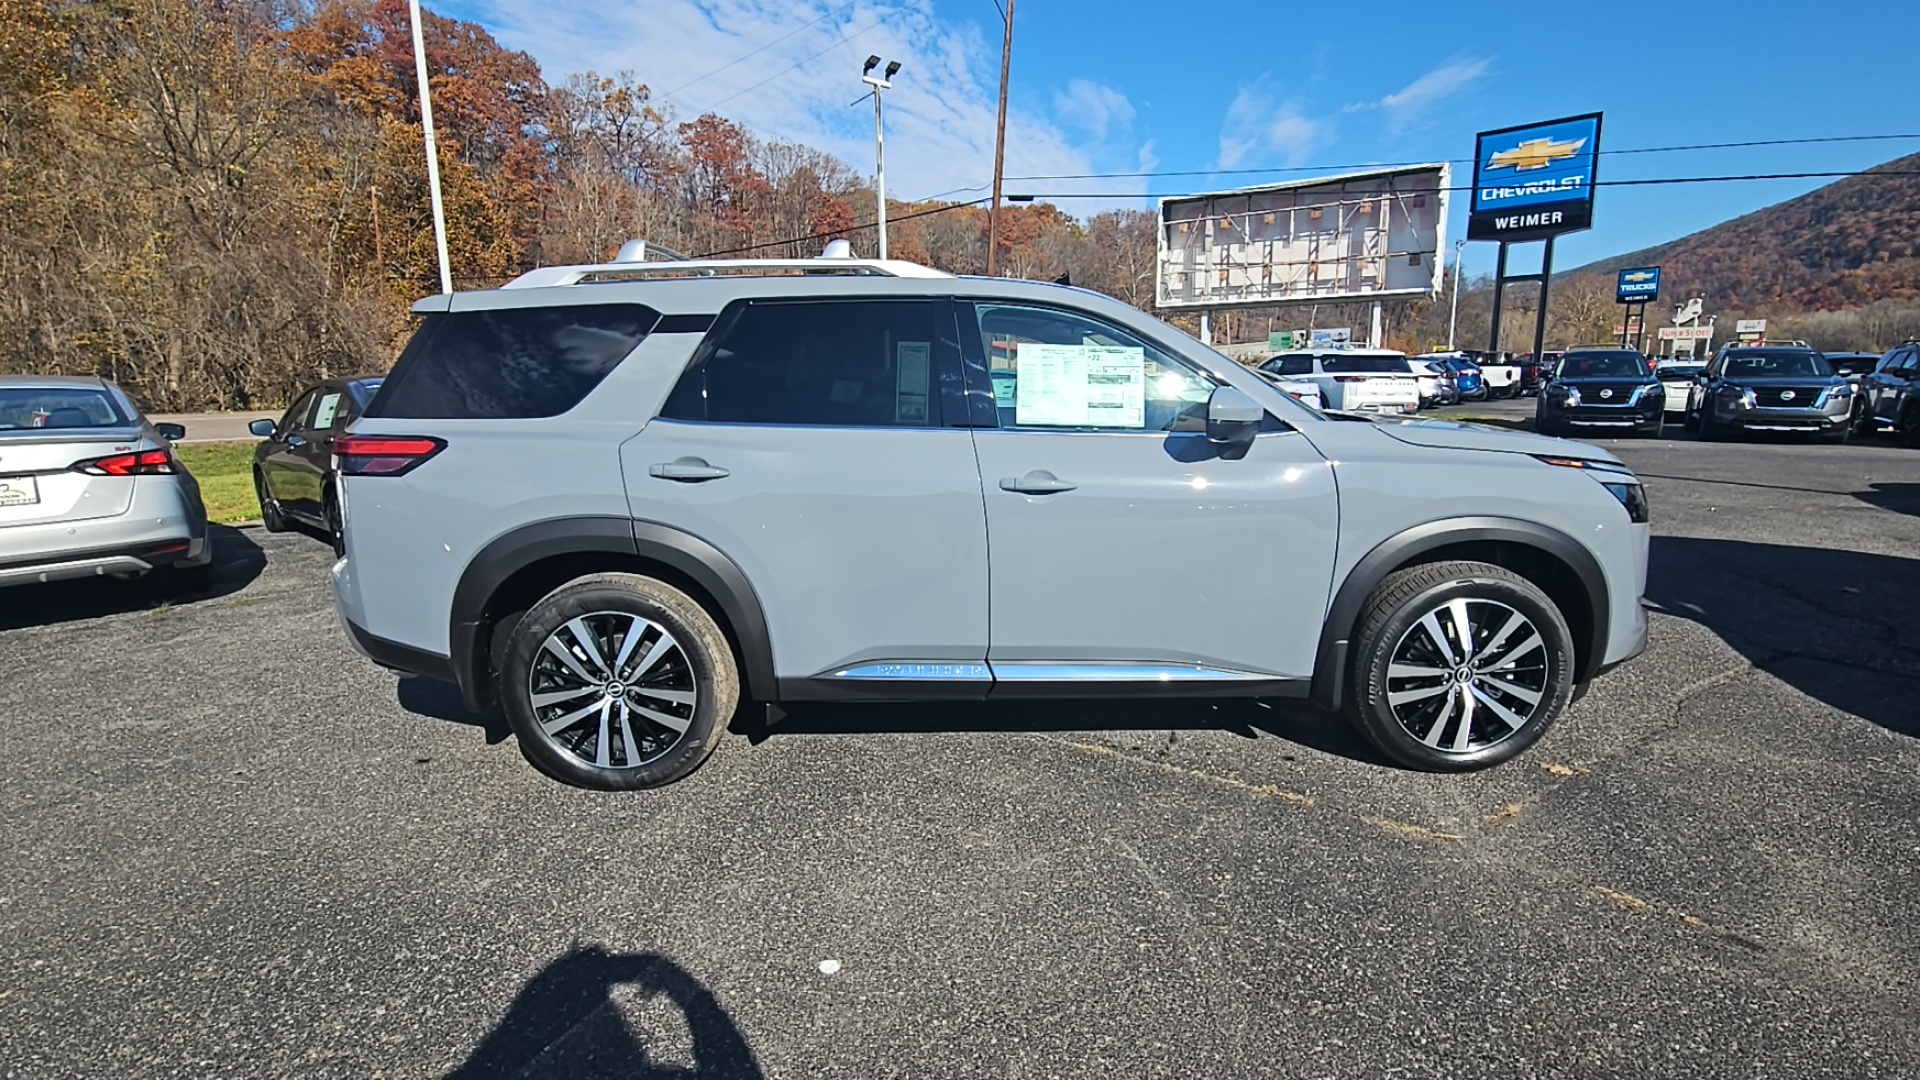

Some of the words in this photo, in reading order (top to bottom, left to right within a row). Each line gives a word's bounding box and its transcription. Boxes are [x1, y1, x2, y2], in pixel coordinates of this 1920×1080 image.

[1481, 175, 1584, 201] CHEVROLET
[1495, 211, 1563, 230] WEIMER
[1620, 283, 1656, 292] TRUCKS
[1368, 621, 1402, 706] BRIDGESTONE
[1532, 650, 1567, 735] BRIDGESTONE
